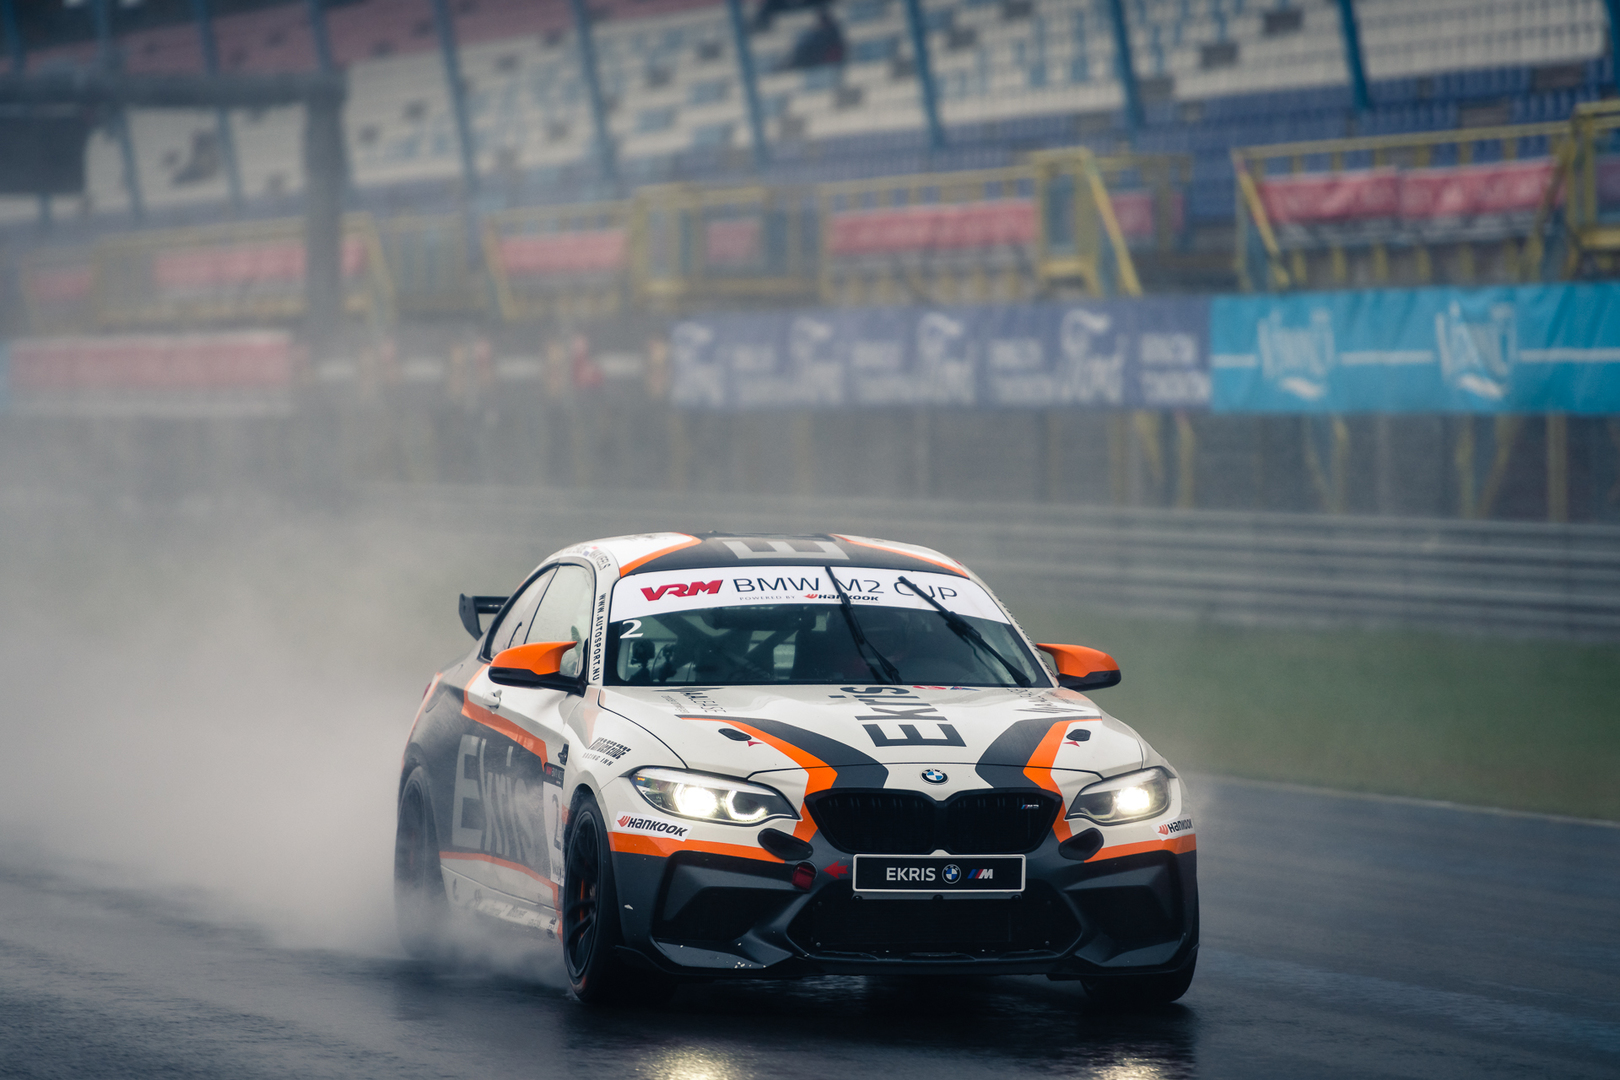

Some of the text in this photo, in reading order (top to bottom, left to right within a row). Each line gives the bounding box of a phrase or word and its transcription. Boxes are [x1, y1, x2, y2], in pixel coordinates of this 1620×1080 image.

[640, 579, 723, 602] VRM
[733, 577, 819, 593] BMW
[831, 578, 884, 594] M2
[592, 592, 606, 681] WWW.AUTOSPORT.NU
[620, 619, 644, 639] 2
[828, 686, 967, 748] Ekris
[886, 867, 936, 881] EKRIS
